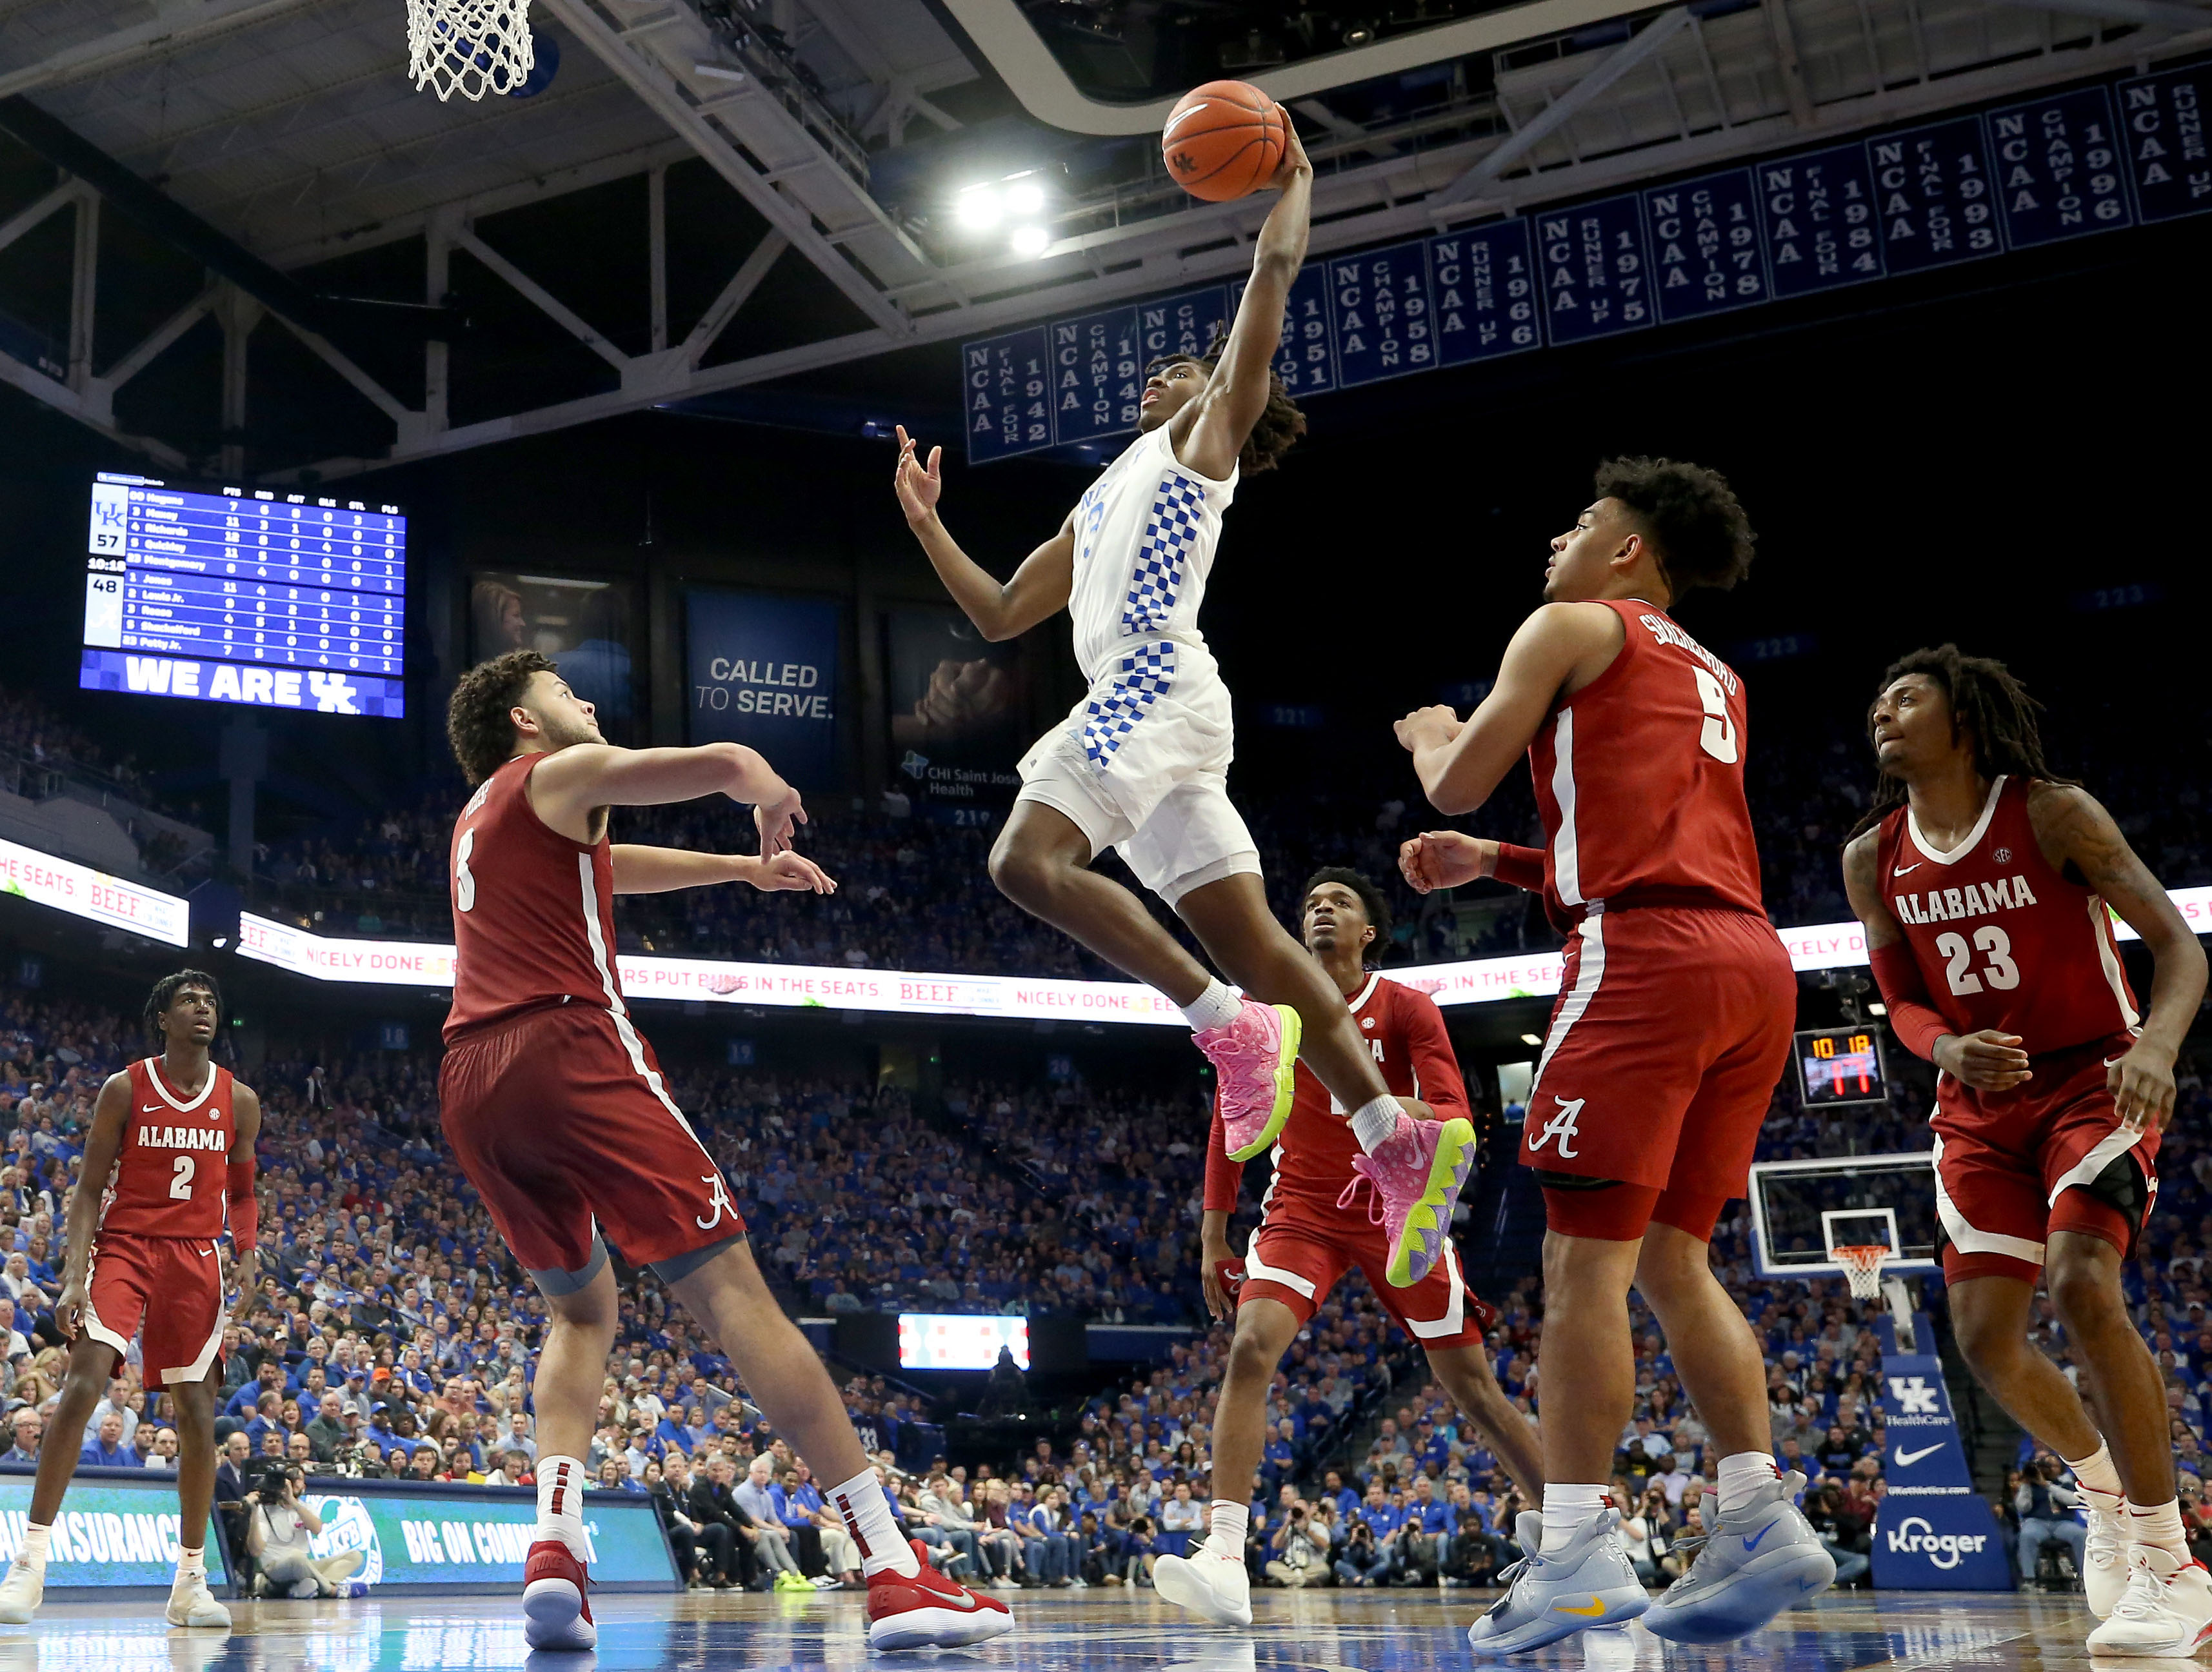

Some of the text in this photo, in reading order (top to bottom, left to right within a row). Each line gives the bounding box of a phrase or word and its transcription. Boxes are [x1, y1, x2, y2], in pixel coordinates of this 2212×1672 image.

[2126, 84, 2173, 186] NCAA
[1996, 114, 2040, 214] NCAA
[2084, 123, 2122, 220] 1996
[1874, 141, 1916, 241] NCAA
[1958, 153, 1995, 250] 1993
[1766, 168, 1803, 264] NCAA
[1844, 179, 1878, 272] 1984
[1652, 194, 1691, 288] NCAA
[1729, 202, 1760, 295] 1978
[1436, 241, 1466, 333] NCAA
[1544, 218, 1579, 312] NCAA
[1616, 230, 1645, 321] 1975
[1337, 263, 1366, 354] NCAA
[1404, 274, 1431, 363] 1958
[1506, 255, 1533, 345] 1966
[1304, 299, 1326, 385] 1951
[970, 349, 992, 432] NCAA
[1057, 326, 1081, 410] NCAA
[1117, 339, 1139, 423] 1948
[1026, 359, 1046, 442] 1942
[95, 501, 125, 528] UK
[226, 516, 240, 528] 11
[229, 501, 239, 512] 7
[287, 494, 305, 504] AST
[348, 501, 366, 511] STL
[97, 534, 118, 548] 57
[224, 531, 240, 543] 12
[224, 547, 239, 559] 11
[93, 579, 117, 593] 48
[223, 582, 237, 593] 11
[224, 613, 234, 624] 4
[223, 644, 233, 655] 7
[710, 657, 819, 688] CALLED
[125, 656, 201, 697] WE
[208, 665, 302, 706] ARE
[695, 686, 833, 719] TO SERVE.
[1691, 664, 1739, 764] 5
[928, 768, 950, 780] CHI
[954, 769, 987, 782] Saint
[930, 782, 974, 796] Health
[24, 864, 77, 897] SEATS.
[1895, 875, 2037, 924] ALABAMA
[306, 947, 364, 967] NICELY
[1788, 937, 1840, 956] CELY
[1935, 925, 2020, 996] 23
[655, 971, 692, 986] PUT
[755, 977, 773, 991] IN
[779, 979, 815, 993] THE
[821, 980, 883, 997] SEATS.
[1017, 990, 1077, 1006] NICELY
[1455, 976, 1474, 990] IN
[1480, 970, 1520, 986] THE
[1528, 966, 1566, 982] SEA
[732, 1045, 752, 1059] 19
[1813, 1035, 1869, 1059] 10 18
[1831, 1057, 1869, 1095] 17
[137, 1126, 225, 1151] ALABAMA
[1528, 1095, 1586, 1159] A
[169, 1155, 195, 1200] 2
[697, 1172, 739, 1229] A
[1888, 1377, 1940, 1413] UK
[46, 1511, 181, 1563] NSURANC
[401, 1520, 443, 1564] BIG
[441, 1521, 477, 1564] ON
[1887, 1517, 1987, 1569] Kroger
